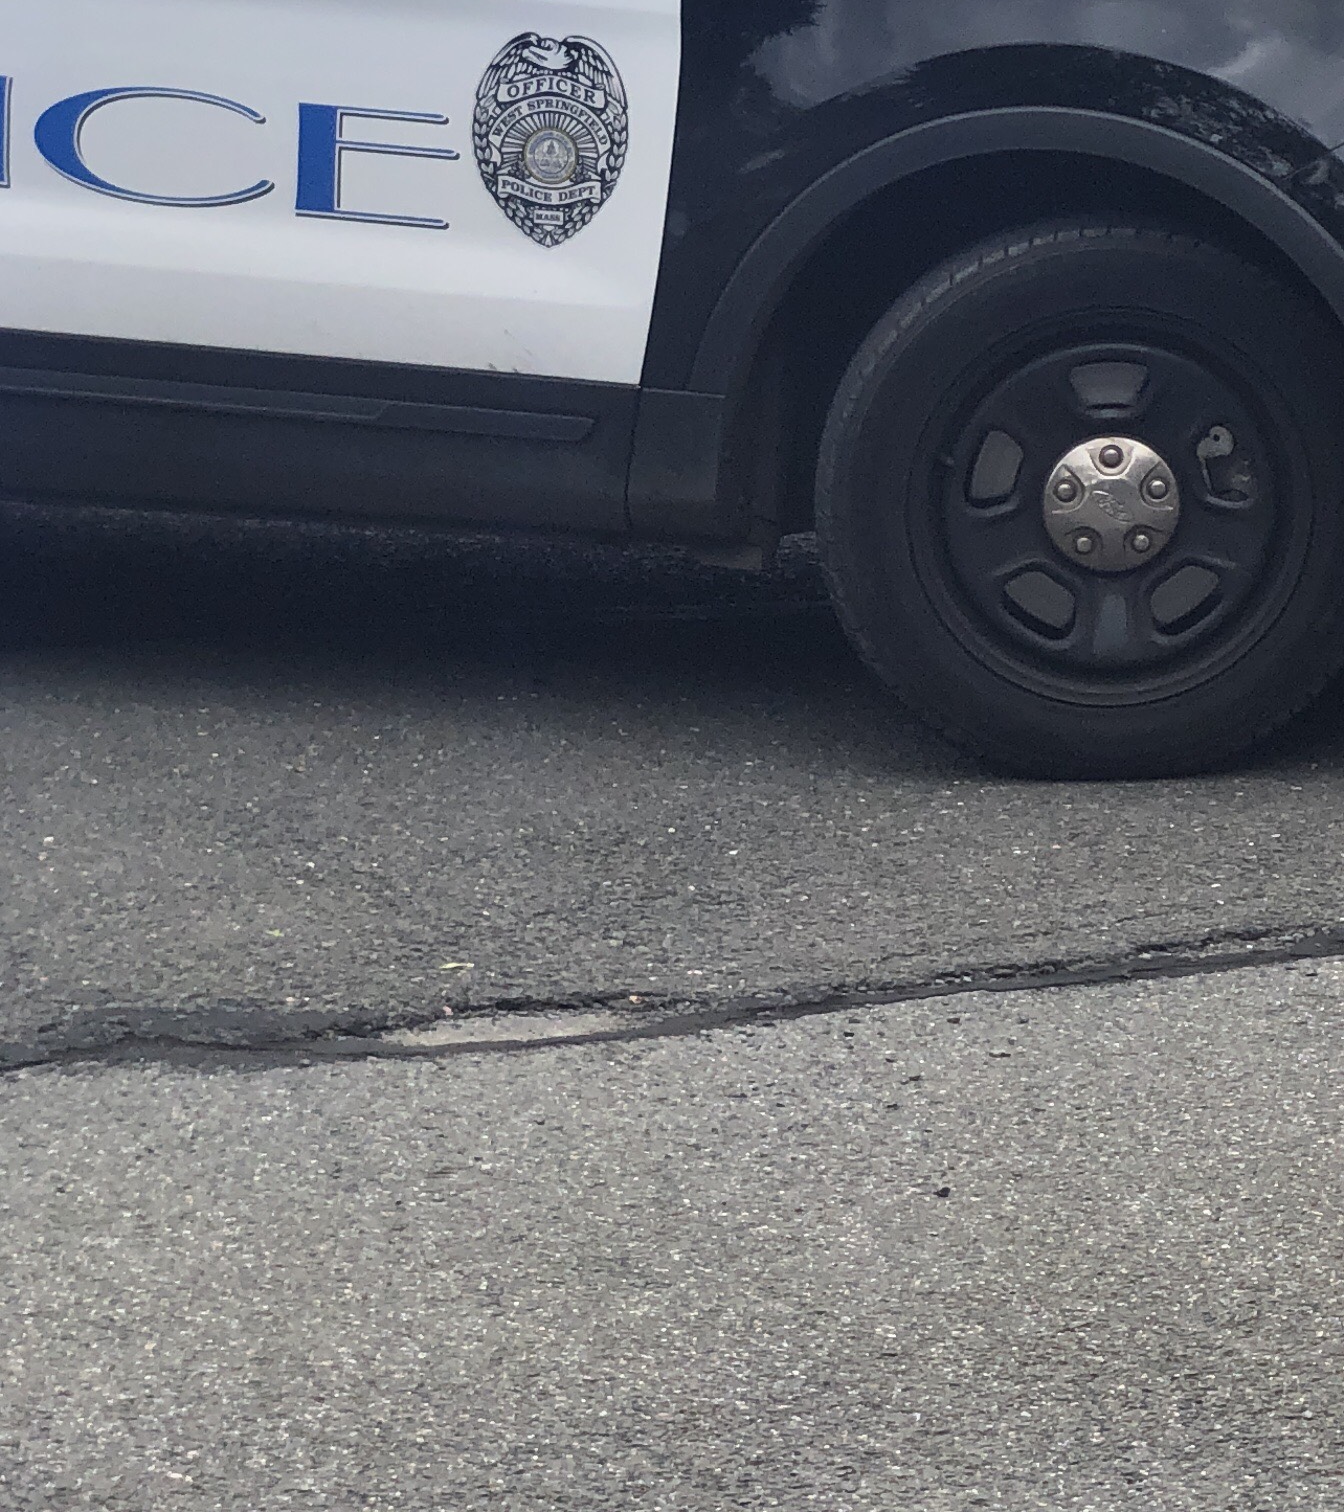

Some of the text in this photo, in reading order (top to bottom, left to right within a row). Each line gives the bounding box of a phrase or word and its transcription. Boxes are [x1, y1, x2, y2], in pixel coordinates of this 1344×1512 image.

[506, 77, 597, 105] OFFICER
[492, 96, 608, 145] WEST SPRINGFIELD
[501, 179, 597, 203] POLICE DEPT
[535, 212, 561, 223] MASS
